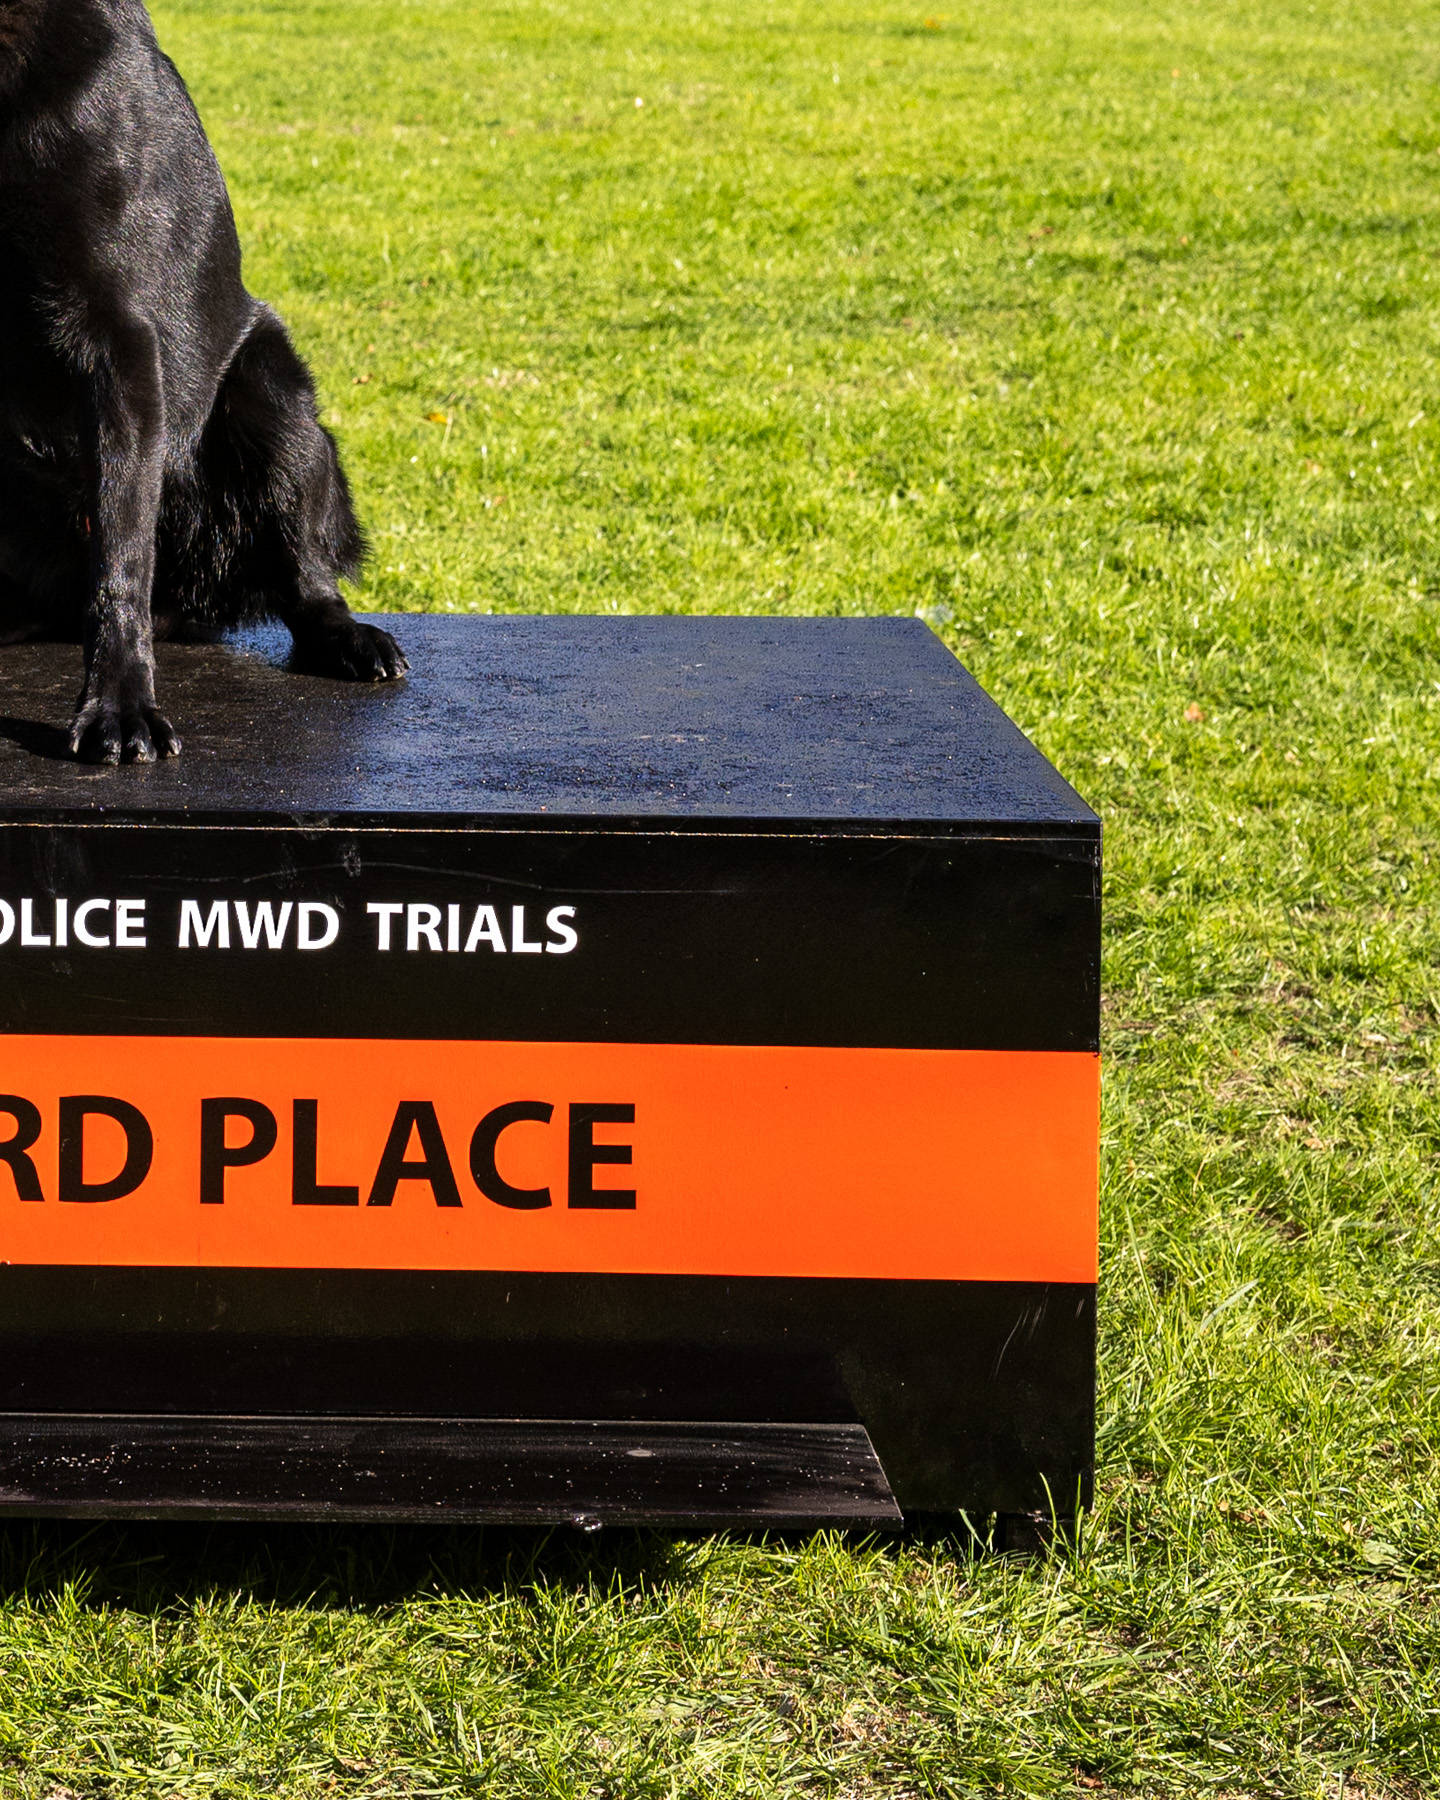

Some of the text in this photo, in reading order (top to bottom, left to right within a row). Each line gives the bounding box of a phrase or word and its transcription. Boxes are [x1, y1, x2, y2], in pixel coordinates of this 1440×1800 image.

[178, 900, 340, 950] MWD
[366, 902, 578, 954] TRIALS
[200, 1097, 637, 1210] PLACE
